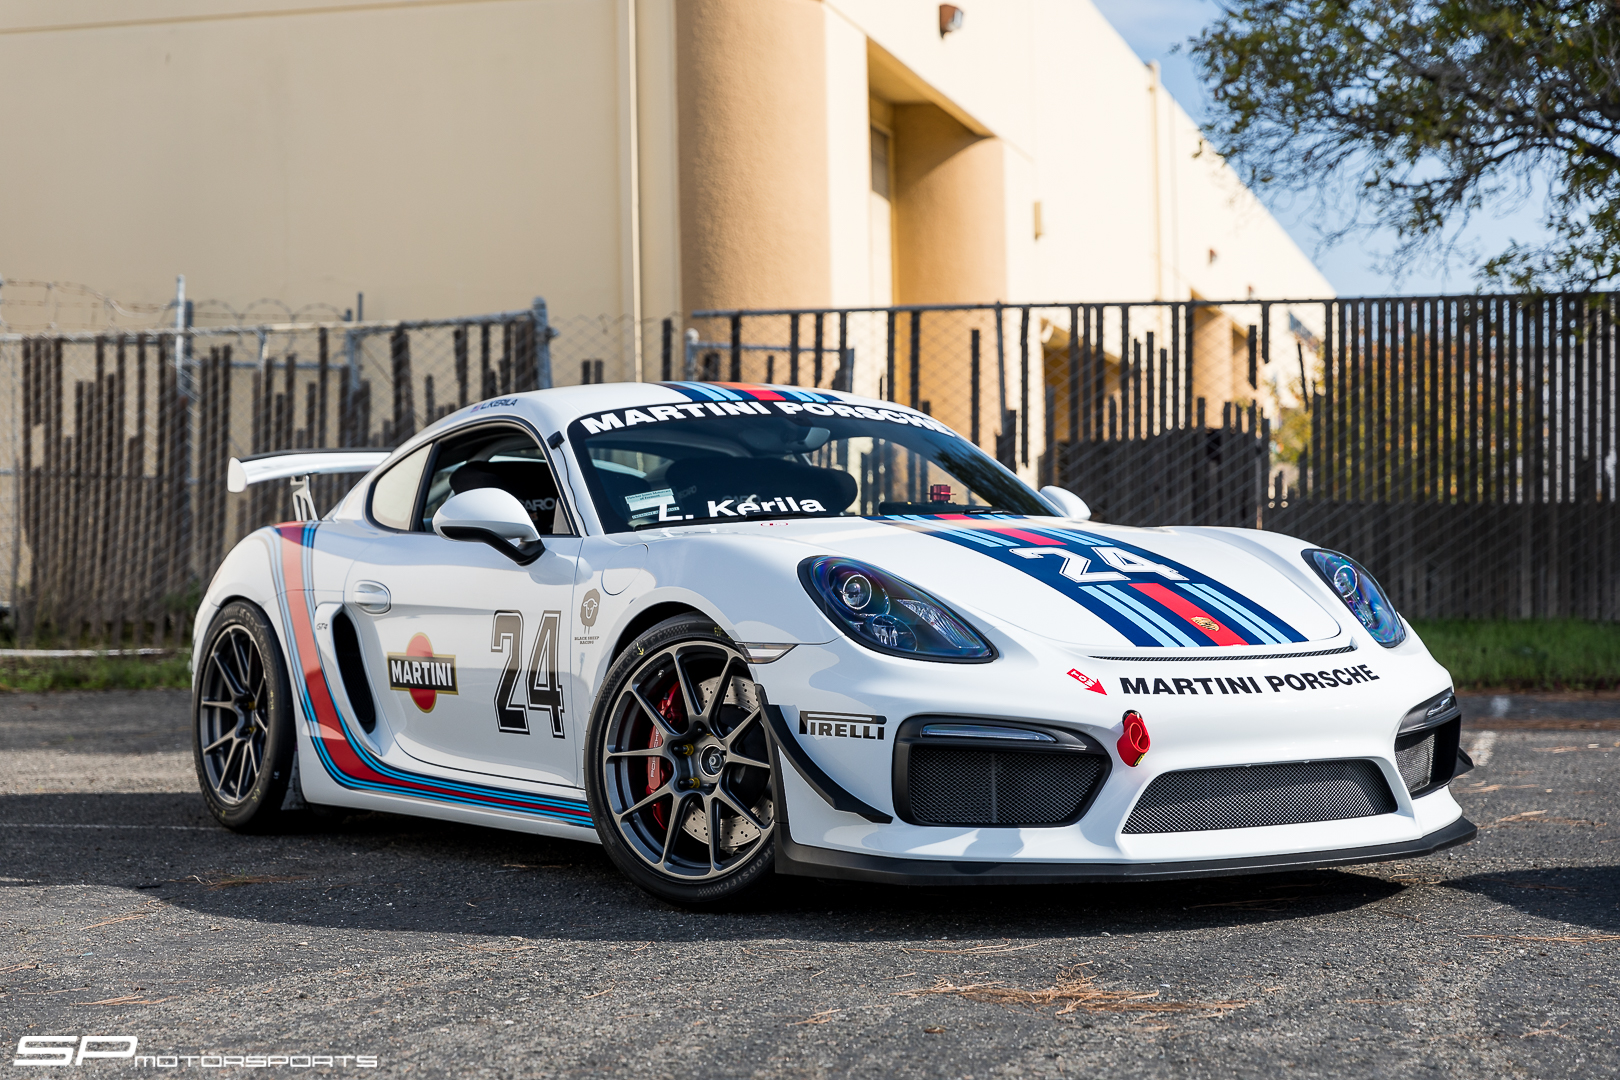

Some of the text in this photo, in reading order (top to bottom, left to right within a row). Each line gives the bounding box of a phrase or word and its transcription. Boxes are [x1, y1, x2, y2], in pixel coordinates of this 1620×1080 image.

[579, 401, 956, 438] MARTINI PORSCHE
[707, 496, 827, 518] Kerila
[1008, 545, 1189, 583] 24
[390, 659, 453, 687] MARTINI
[490, 610, 566, 739] 24
[1070, 670, 1097, 689] TOW
[1118, 663, 1380, 695] MARTINI PORSCHE
[799, 710, 888, 740] PIRELLI
